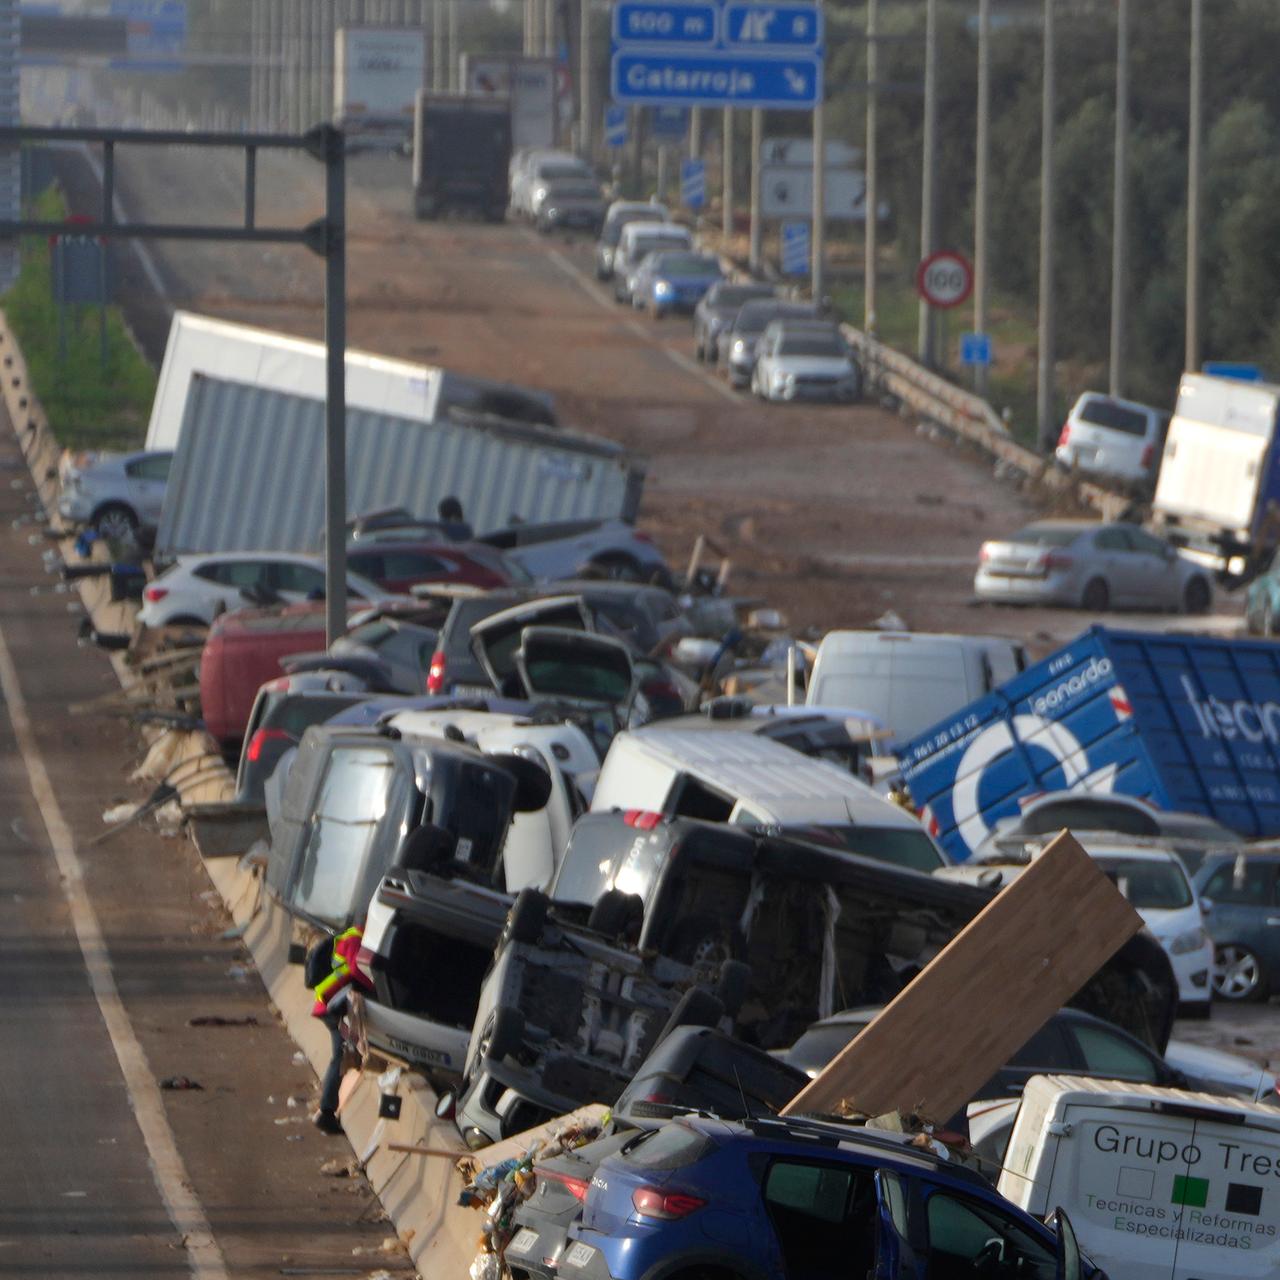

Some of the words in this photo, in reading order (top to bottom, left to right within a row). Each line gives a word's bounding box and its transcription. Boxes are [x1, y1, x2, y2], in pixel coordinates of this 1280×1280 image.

[683, 17, 704, 34] m
[627, 64, 755, 96] Catarroja
[927, 268, 963, 292] 100
[1027, 656, 1113, 717] leonardo
[1094, 1125, 1202, 1165] Grupo
[1086, 1194, 1166, 1219] Tecnicas
[1172, 1209, 1184, 1222] y
[1189, 1210, 1276, 1236] Reformas
